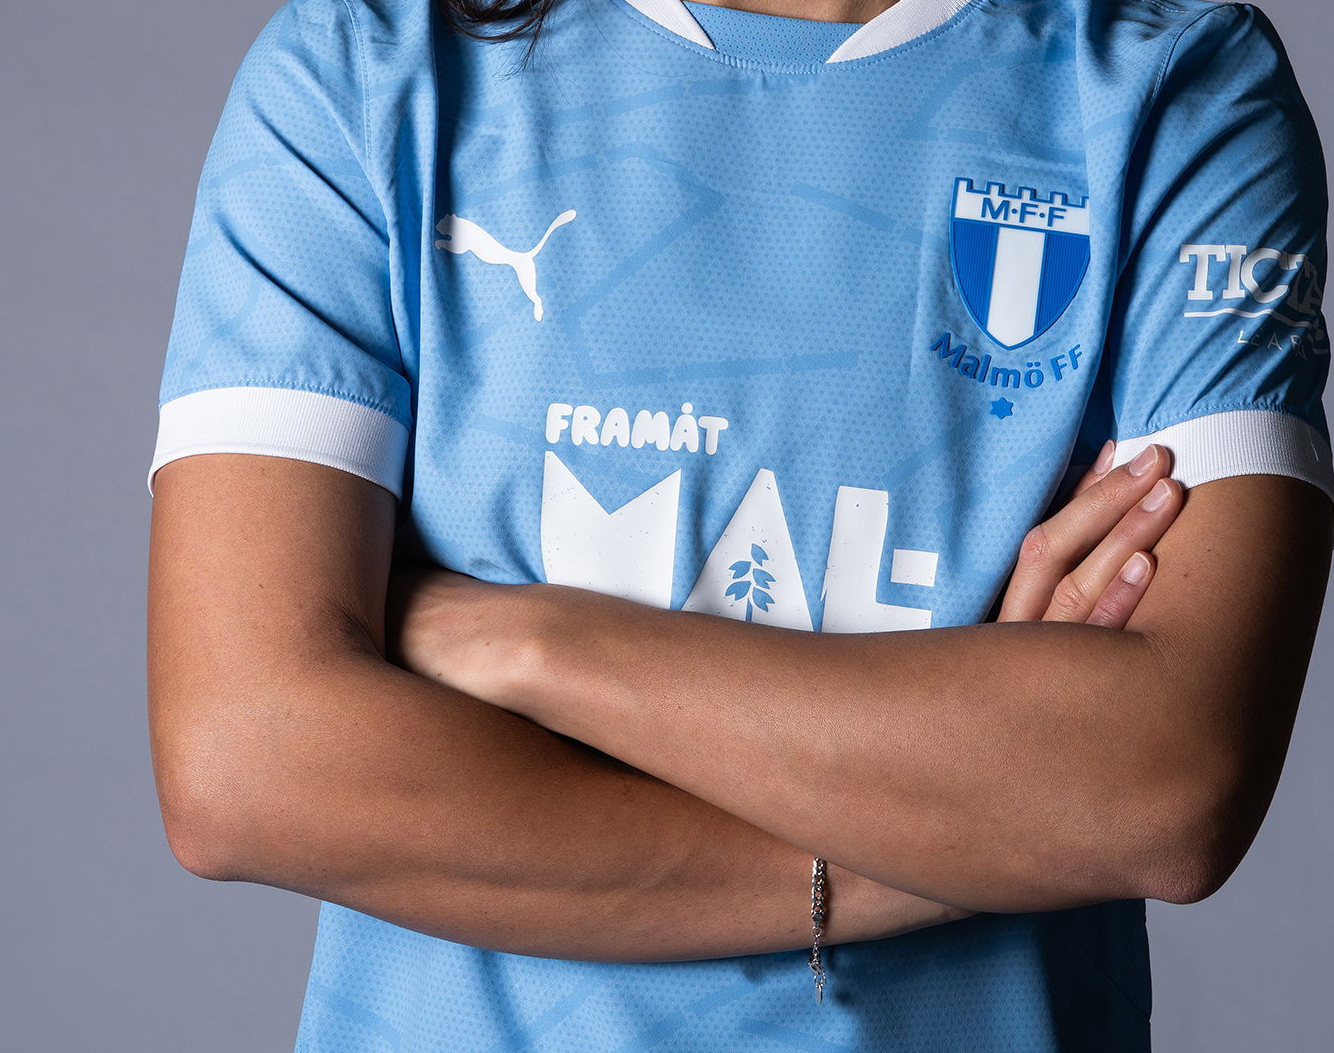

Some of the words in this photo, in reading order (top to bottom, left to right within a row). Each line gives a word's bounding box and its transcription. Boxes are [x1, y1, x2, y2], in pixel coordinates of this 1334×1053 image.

[930, 332, 1044, 388] Malmö
[1051, 344, 1083, 381] FF
[546, 403, 728, 455] FRAMÅT
